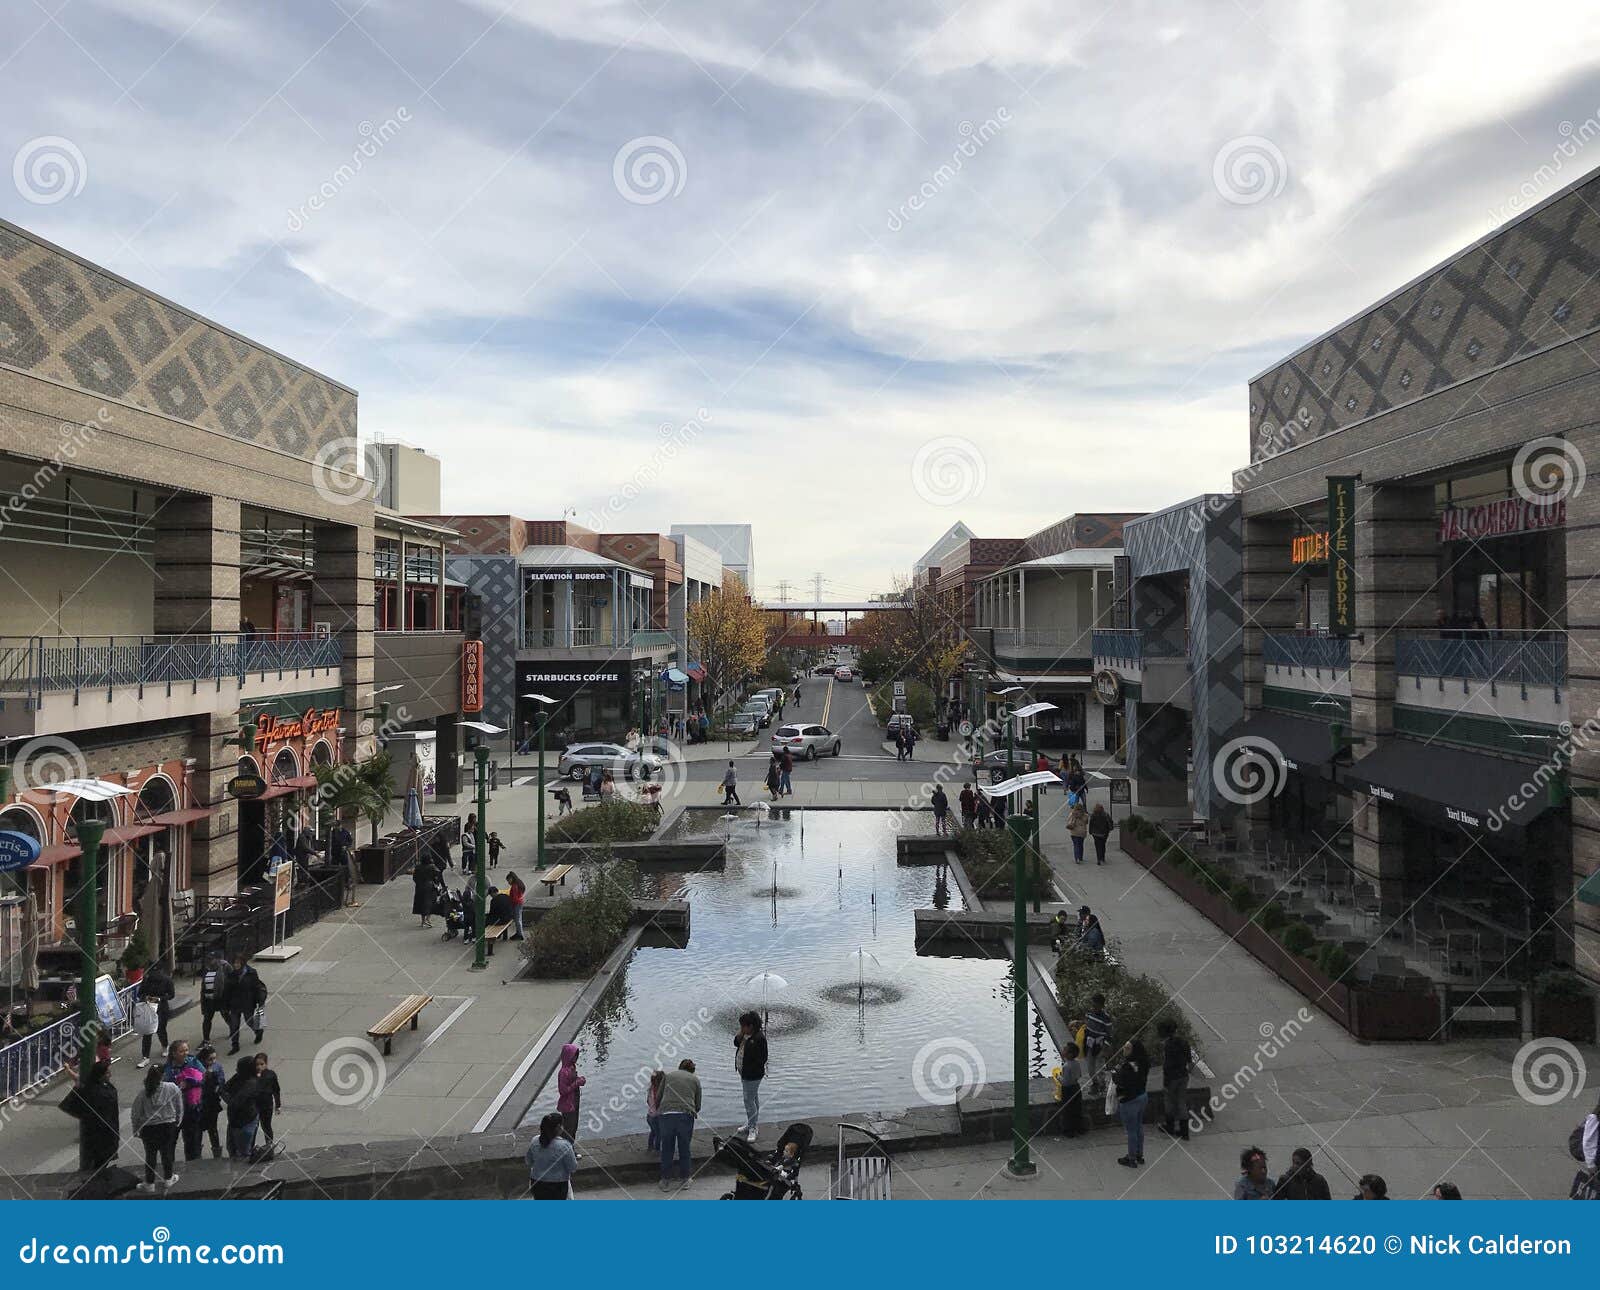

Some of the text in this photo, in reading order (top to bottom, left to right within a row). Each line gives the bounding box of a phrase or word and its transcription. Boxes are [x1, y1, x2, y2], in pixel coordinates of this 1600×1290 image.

[1467, 496, 1526, 537] COMEDY
[1335, 483, 1349, 625] LITTLE BUDDHA
[531, 573, 606, 581] ELEVATION BURGER
[466, 642, 477, 705] HAVANA
[525, 673, 618, 682] STARBUCKS COFFEE
[254, 708, 340, 752] Havana Central
[1446, 807, 1480, 827] Yard House
